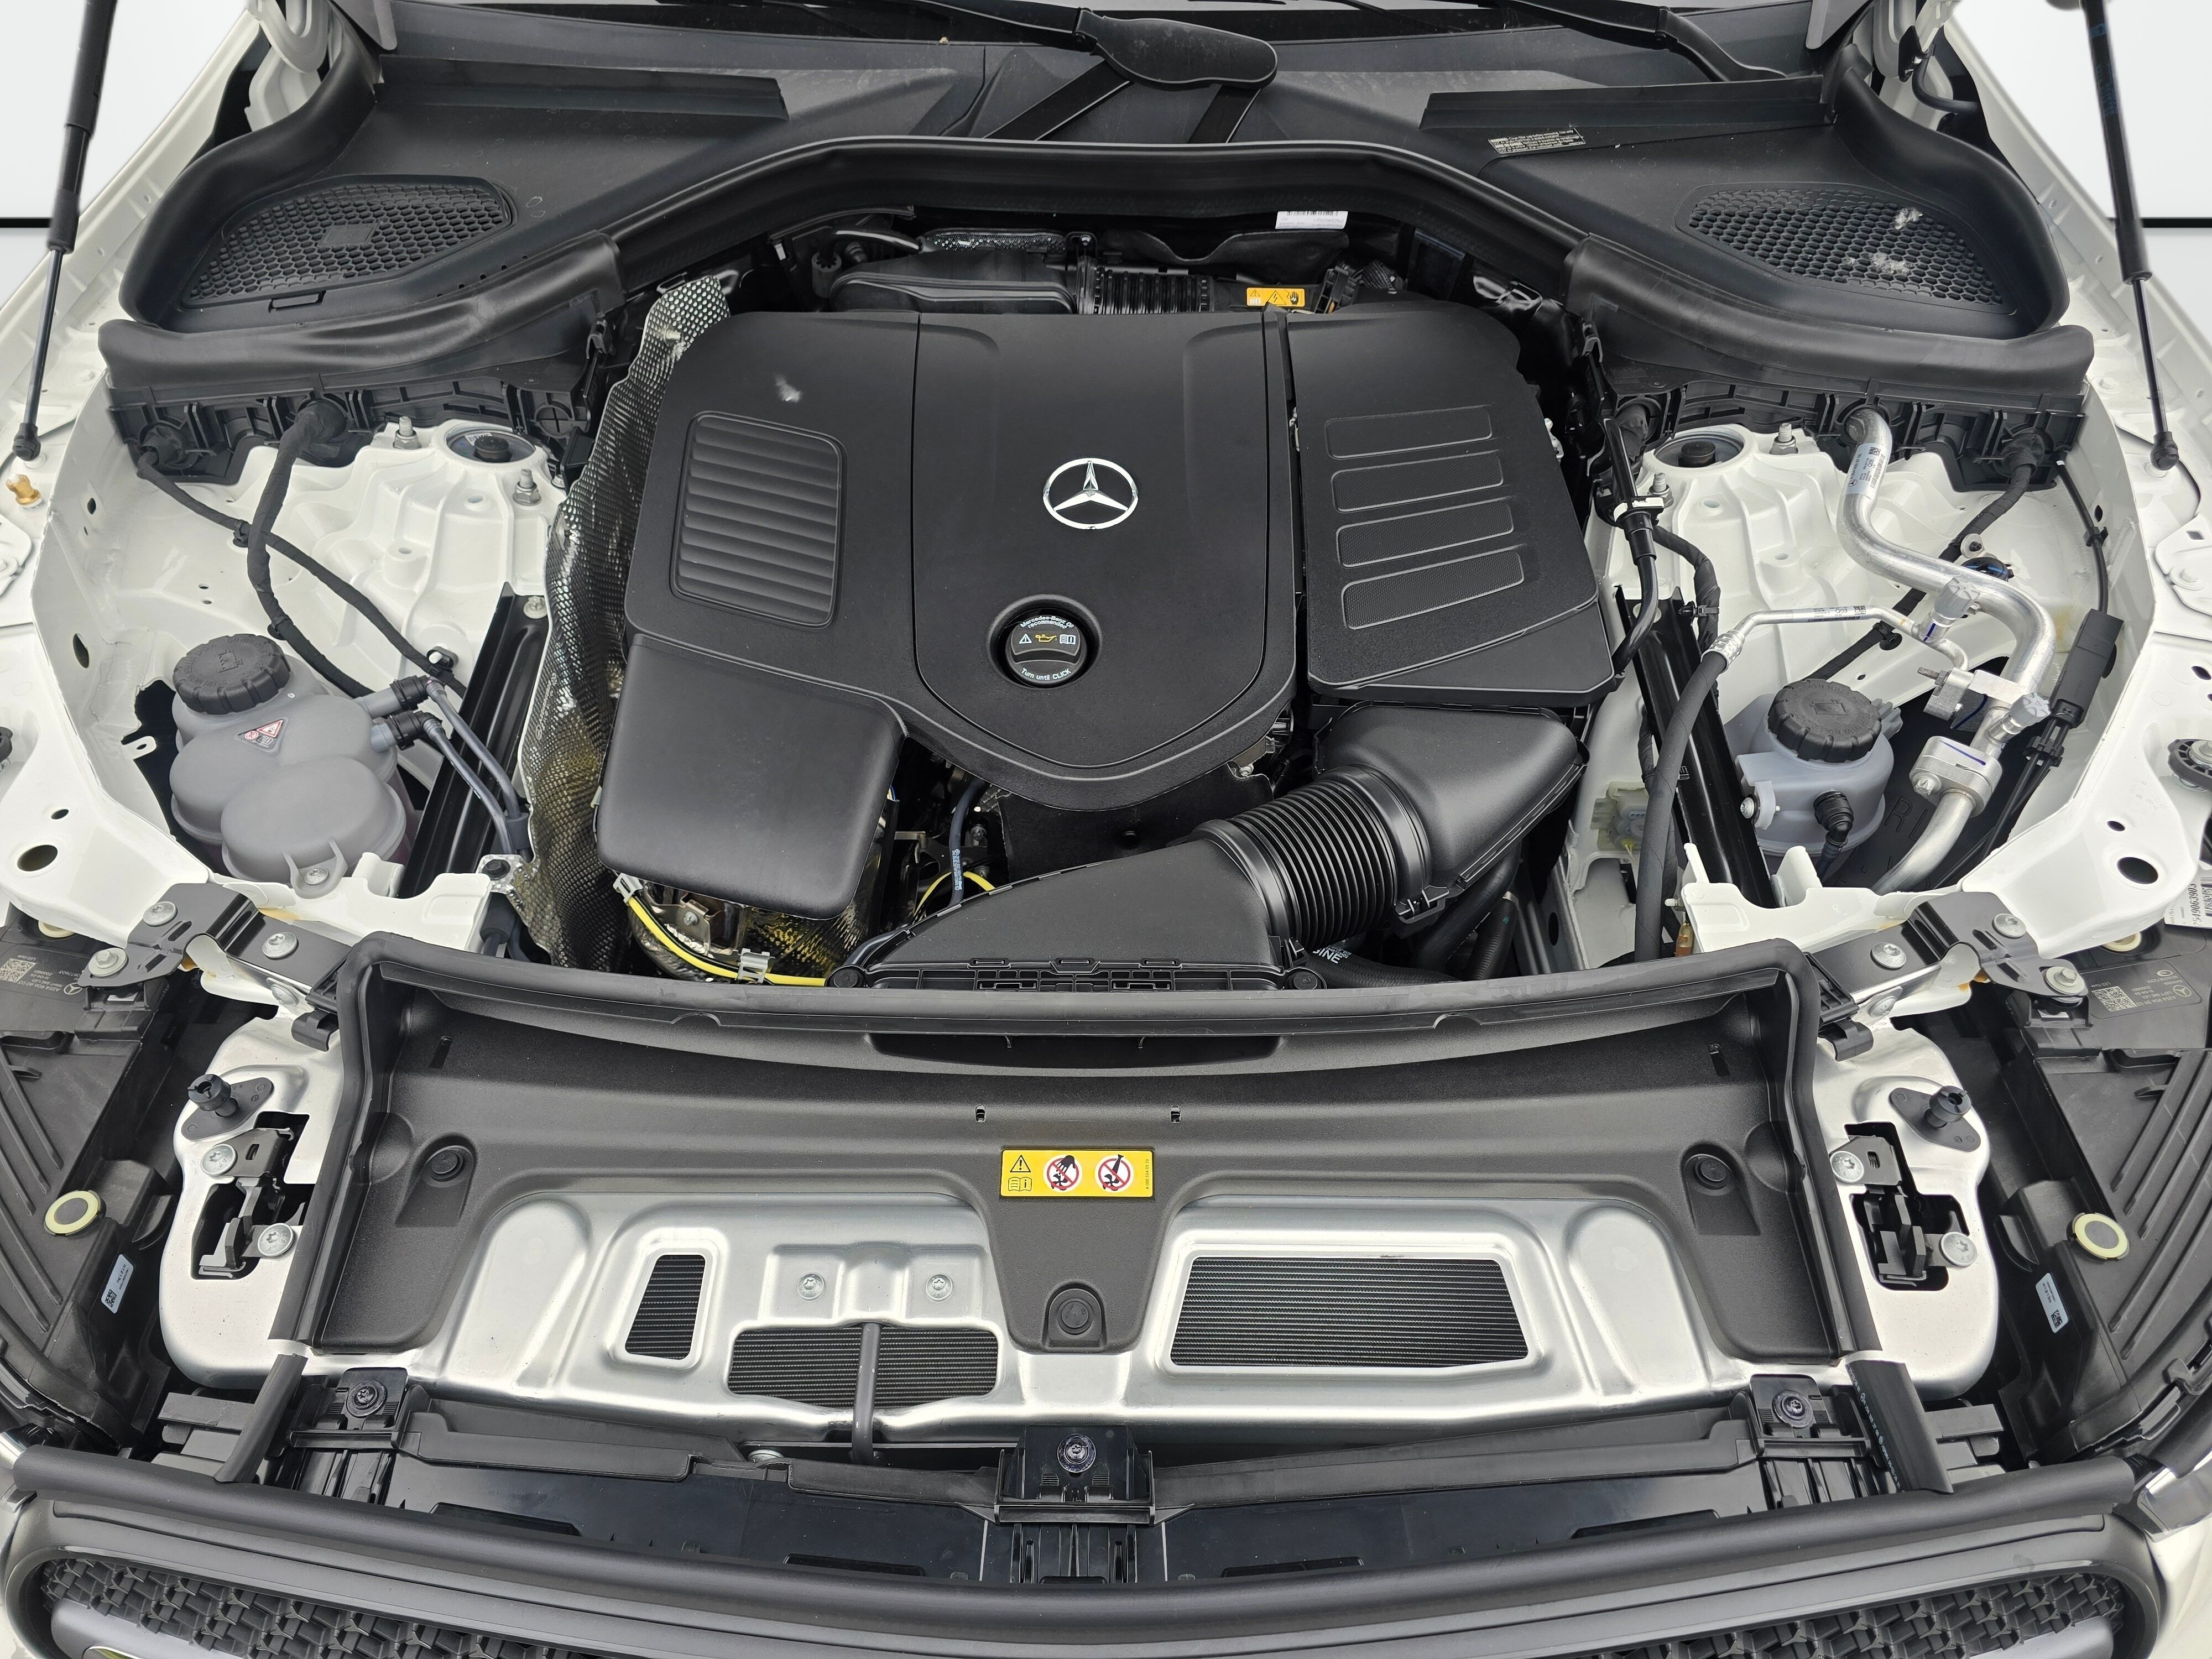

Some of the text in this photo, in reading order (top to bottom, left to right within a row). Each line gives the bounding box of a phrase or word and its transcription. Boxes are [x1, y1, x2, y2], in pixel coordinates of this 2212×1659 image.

[1020, 615, 1066, 628] Mercedes-Benz
[1027, 620, 1068, 629] recommended
[1021, 668, 1034, 679] Turn
[1052, 668, 1072, 680] CLICK
